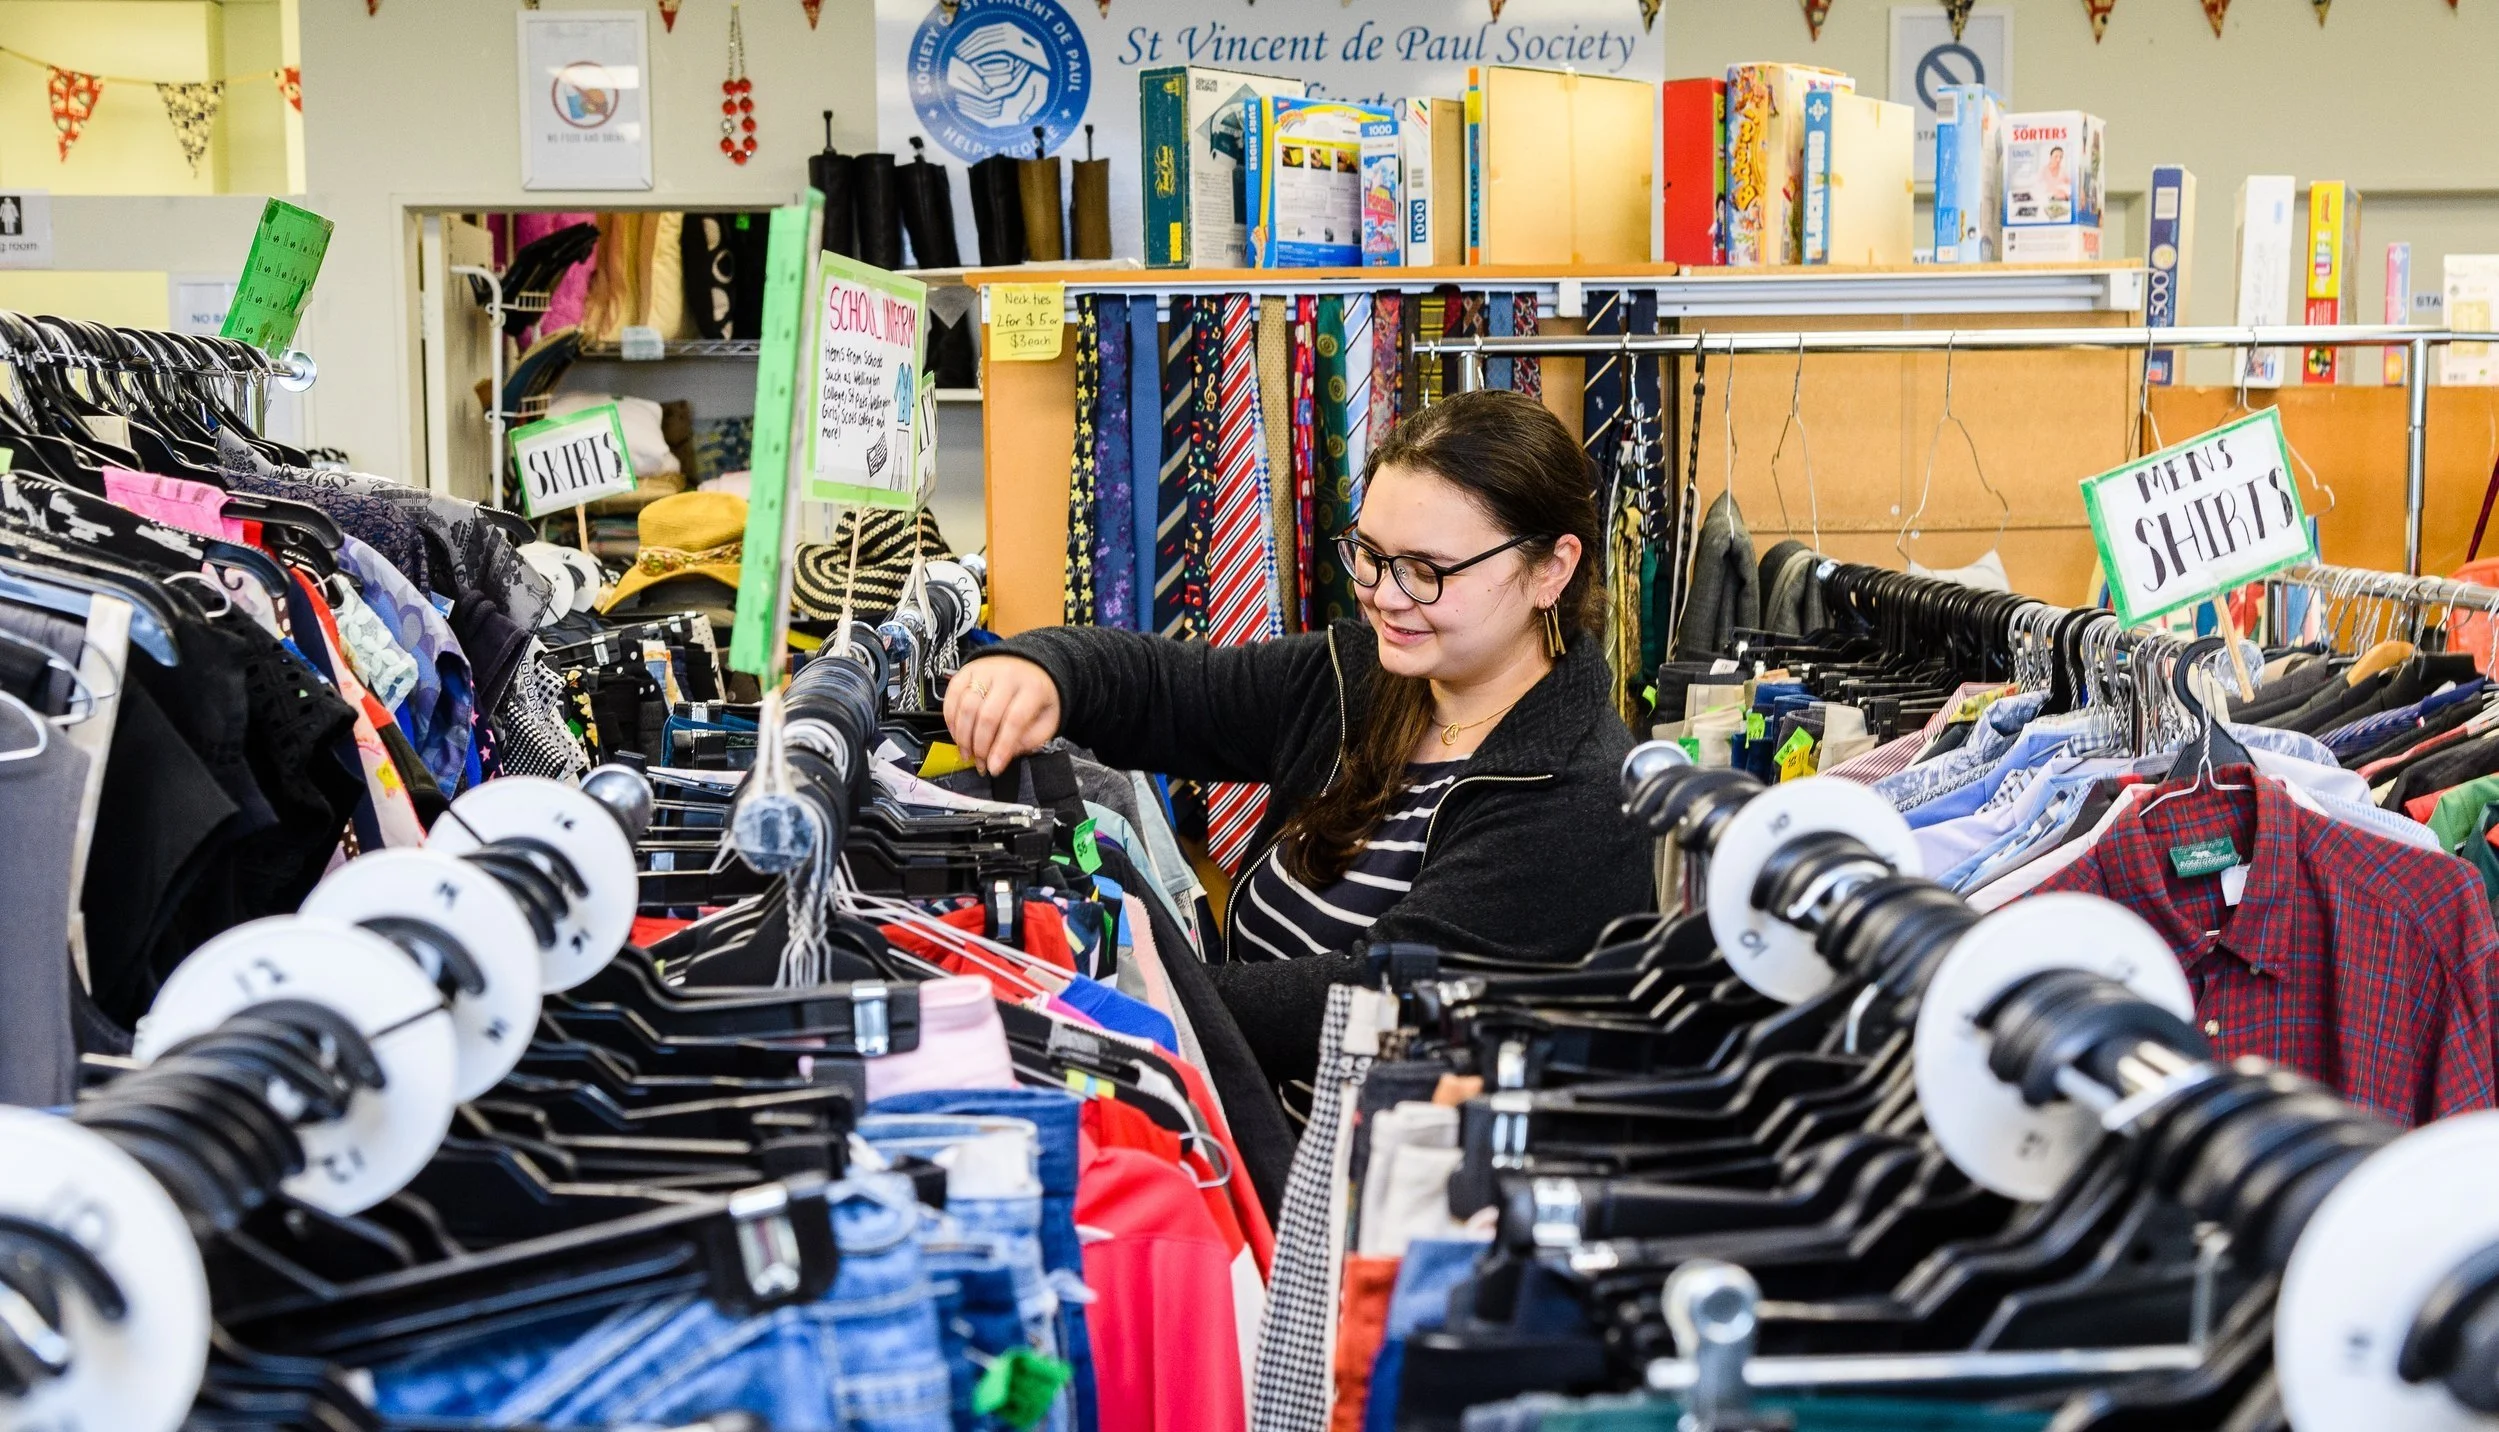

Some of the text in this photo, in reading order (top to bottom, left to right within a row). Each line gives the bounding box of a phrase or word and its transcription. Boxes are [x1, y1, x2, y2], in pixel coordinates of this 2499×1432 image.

[916, 26, 940, 96] SOCIETY
[1052, 22, 1073, 45] DE
[1066, 49, 1082, 93] PAUL
[1118, 19, 1636, 74] St Vincent de Paul Society
[1248, 103, 1257, 134] SURF
[1368, 124, 1392, 136] 1000
[943, 124, 1060, 157] HELPS PEOPE
[1414, 201, 1426, 242] 1000
[1005, 292, 1052, 305] Neck ties
[2149, 270, 2170, 316] 500
[2415, 295, 2443, 306] STA
[192, 314, 210, 323] NO
[528, 431, 623, 499] SKIRTS
[2135, 439, 2234, 504] MENS
[2135, 465, 2294, 592] SHIRTS
